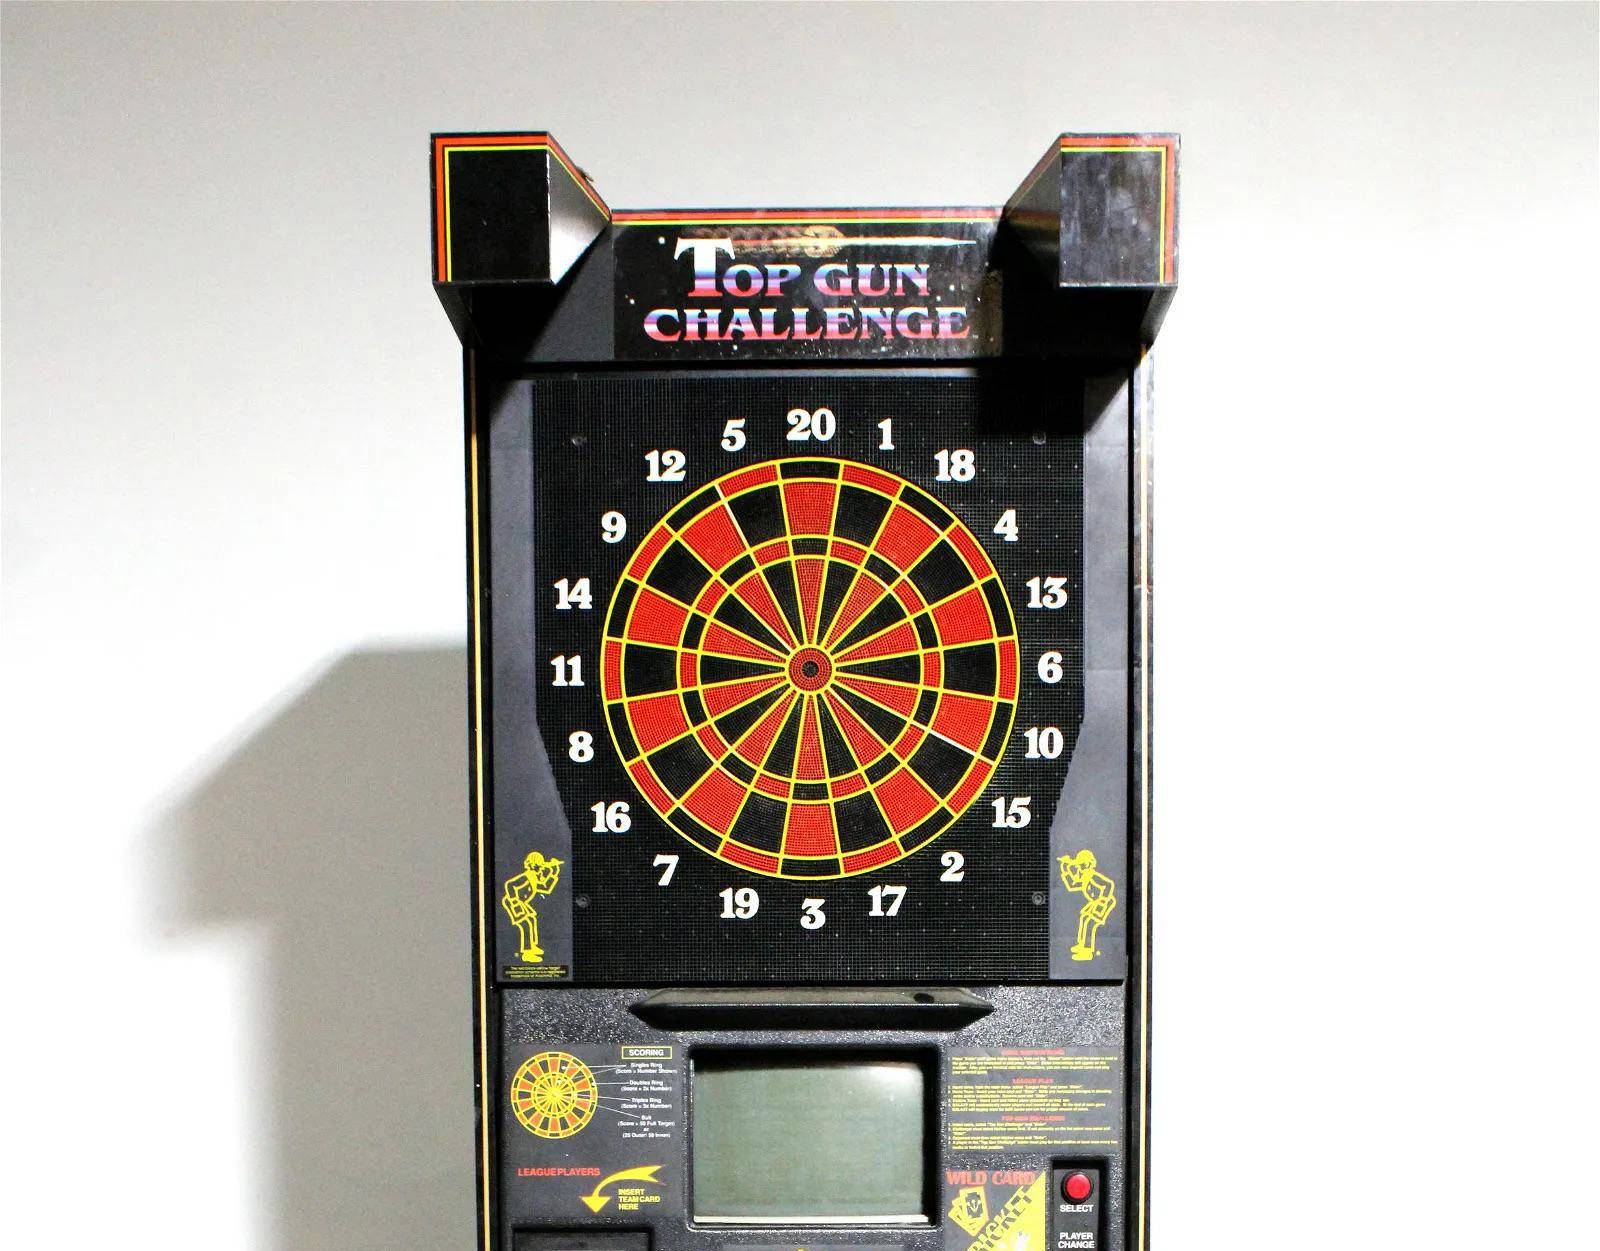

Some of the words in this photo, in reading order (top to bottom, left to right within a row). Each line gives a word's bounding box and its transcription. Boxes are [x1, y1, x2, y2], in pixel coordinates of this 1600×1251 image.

[674, 237, 801, 297] TOP
[813, 263, 930, 297] GUN
[643, 306, 970, 341] CHALLENGE
[721, 419, 746, 451] 5
[787, 409, 836, 441] 20
[878, 419, 895, 451] 1
[645, 450, 686, 482] 12
[934, 449, 975, 482] 18
[601, 511, 627, 543] 9
[993, 509, 1018, 541] 4
[554, 578, 592, 610] 14
[1026, 577, 1067, 609] 13
[551, 655, 584, 687] 11
[1037, 652, 1064, 684] 6
[568, 731, 594, 763] 8
[1024, 727, 1063, 759] 10
[591, 801, 631, 833] 16
[991, 797, 1031, 828] 15
[653, 855, 679, 885] 7
[940, 851, 965, 882] 2
[719, 888, 759, 919] 19
[801, 898, 826, 930] 3
[868, 885, 906, 916] 17
[517, 1168, 557, 1176] LEAGUE
[557, 1168, 600, 1176] PLAYERS
[946, 1170, 987, 1185] WILD
[992, 1170, 1037, 1185] CARD
[1060, 1204, 1094, 1213] SELECT
[1058, 1241, 1095, 1249] CHANGE
[1060, 1232, 1093, 1240] PLAYER
